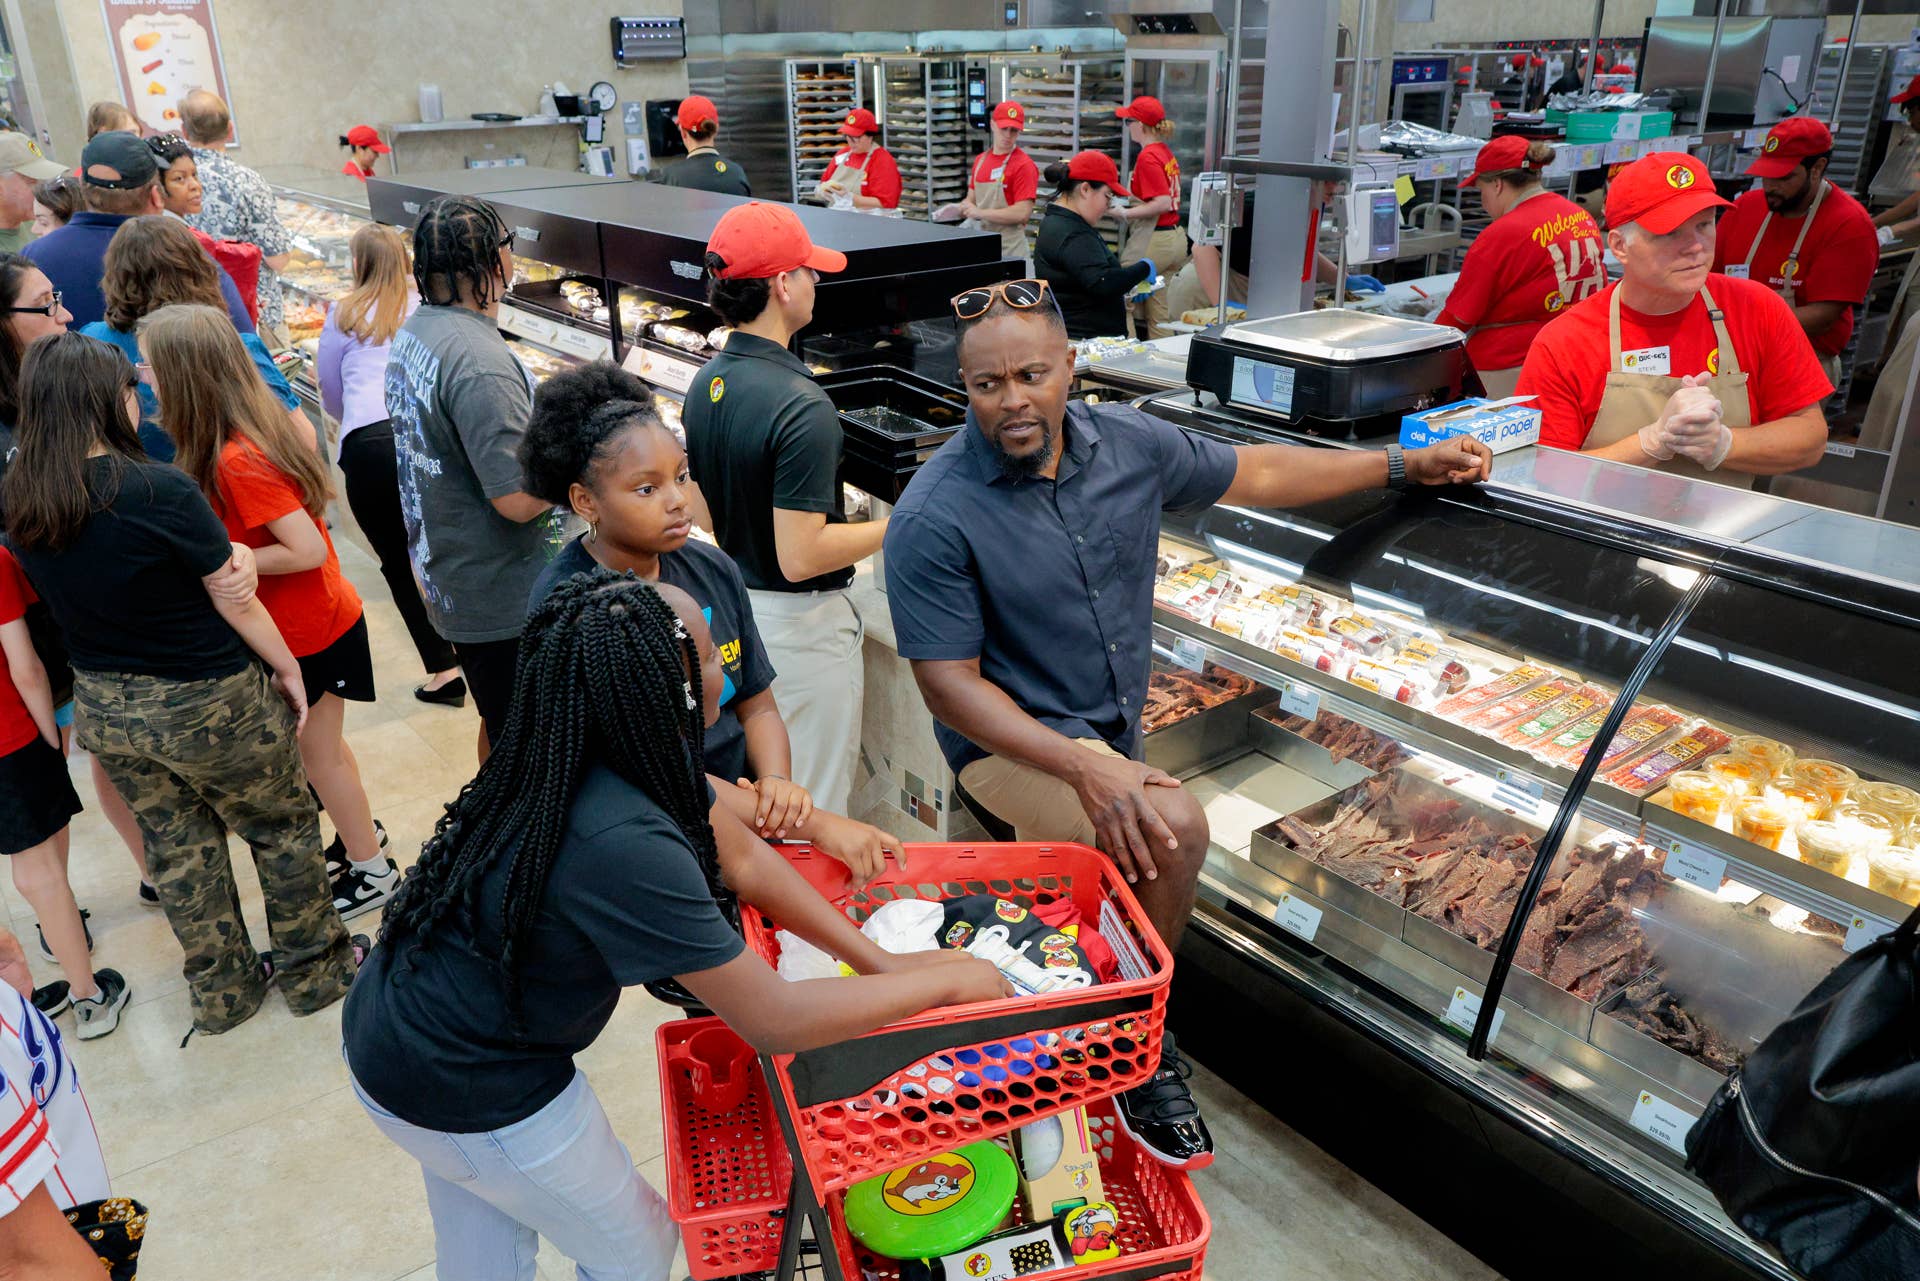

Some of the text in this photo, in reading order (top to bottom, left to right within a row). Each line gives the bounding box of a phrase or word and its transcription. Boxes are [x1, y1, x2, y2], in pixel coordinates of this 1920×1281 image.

[1532, 209, 1589, 248] Welcome
[1410, 430, 1426, 442] deli
[1477, 426, 1497, 443] deli
[1501, 417, 1535, 441] paper
